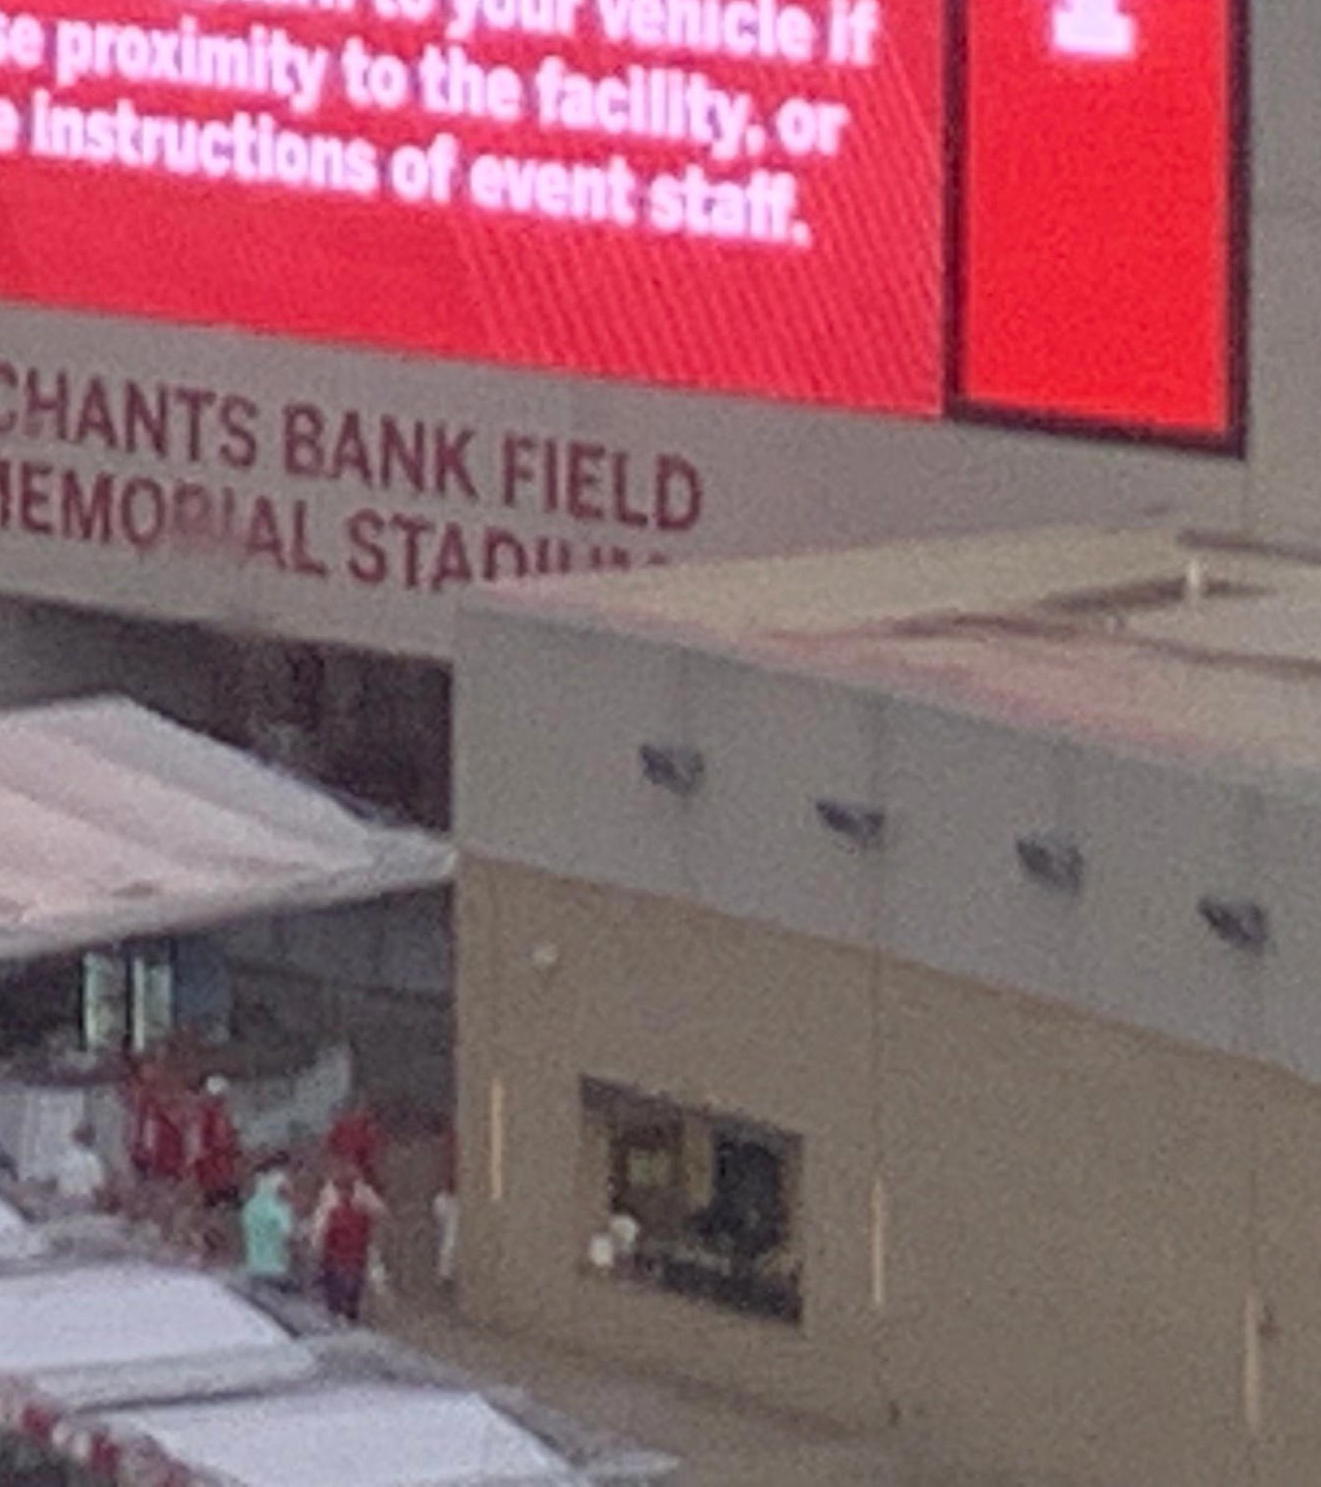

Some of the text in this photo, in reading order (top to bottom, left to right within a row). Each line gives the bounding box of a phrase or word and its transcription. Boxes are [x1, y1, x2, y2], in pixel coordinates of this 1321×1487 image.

[55, 16, 328, 112] proximity
[341, 38, 408, 107] to
[419, 44, 522, 120] the
[534, 56, 766, 159] facility,
[776, 99, 849, 156] or
[30, 87, 376, 194] instructions
[391, 132, 458, 203] of
[469, 154, 637, 226] event
[648, 164, 811, 248] staff.
[284, 402, 477, 502] BANK
[502, 432, 704, 532] FIELD
